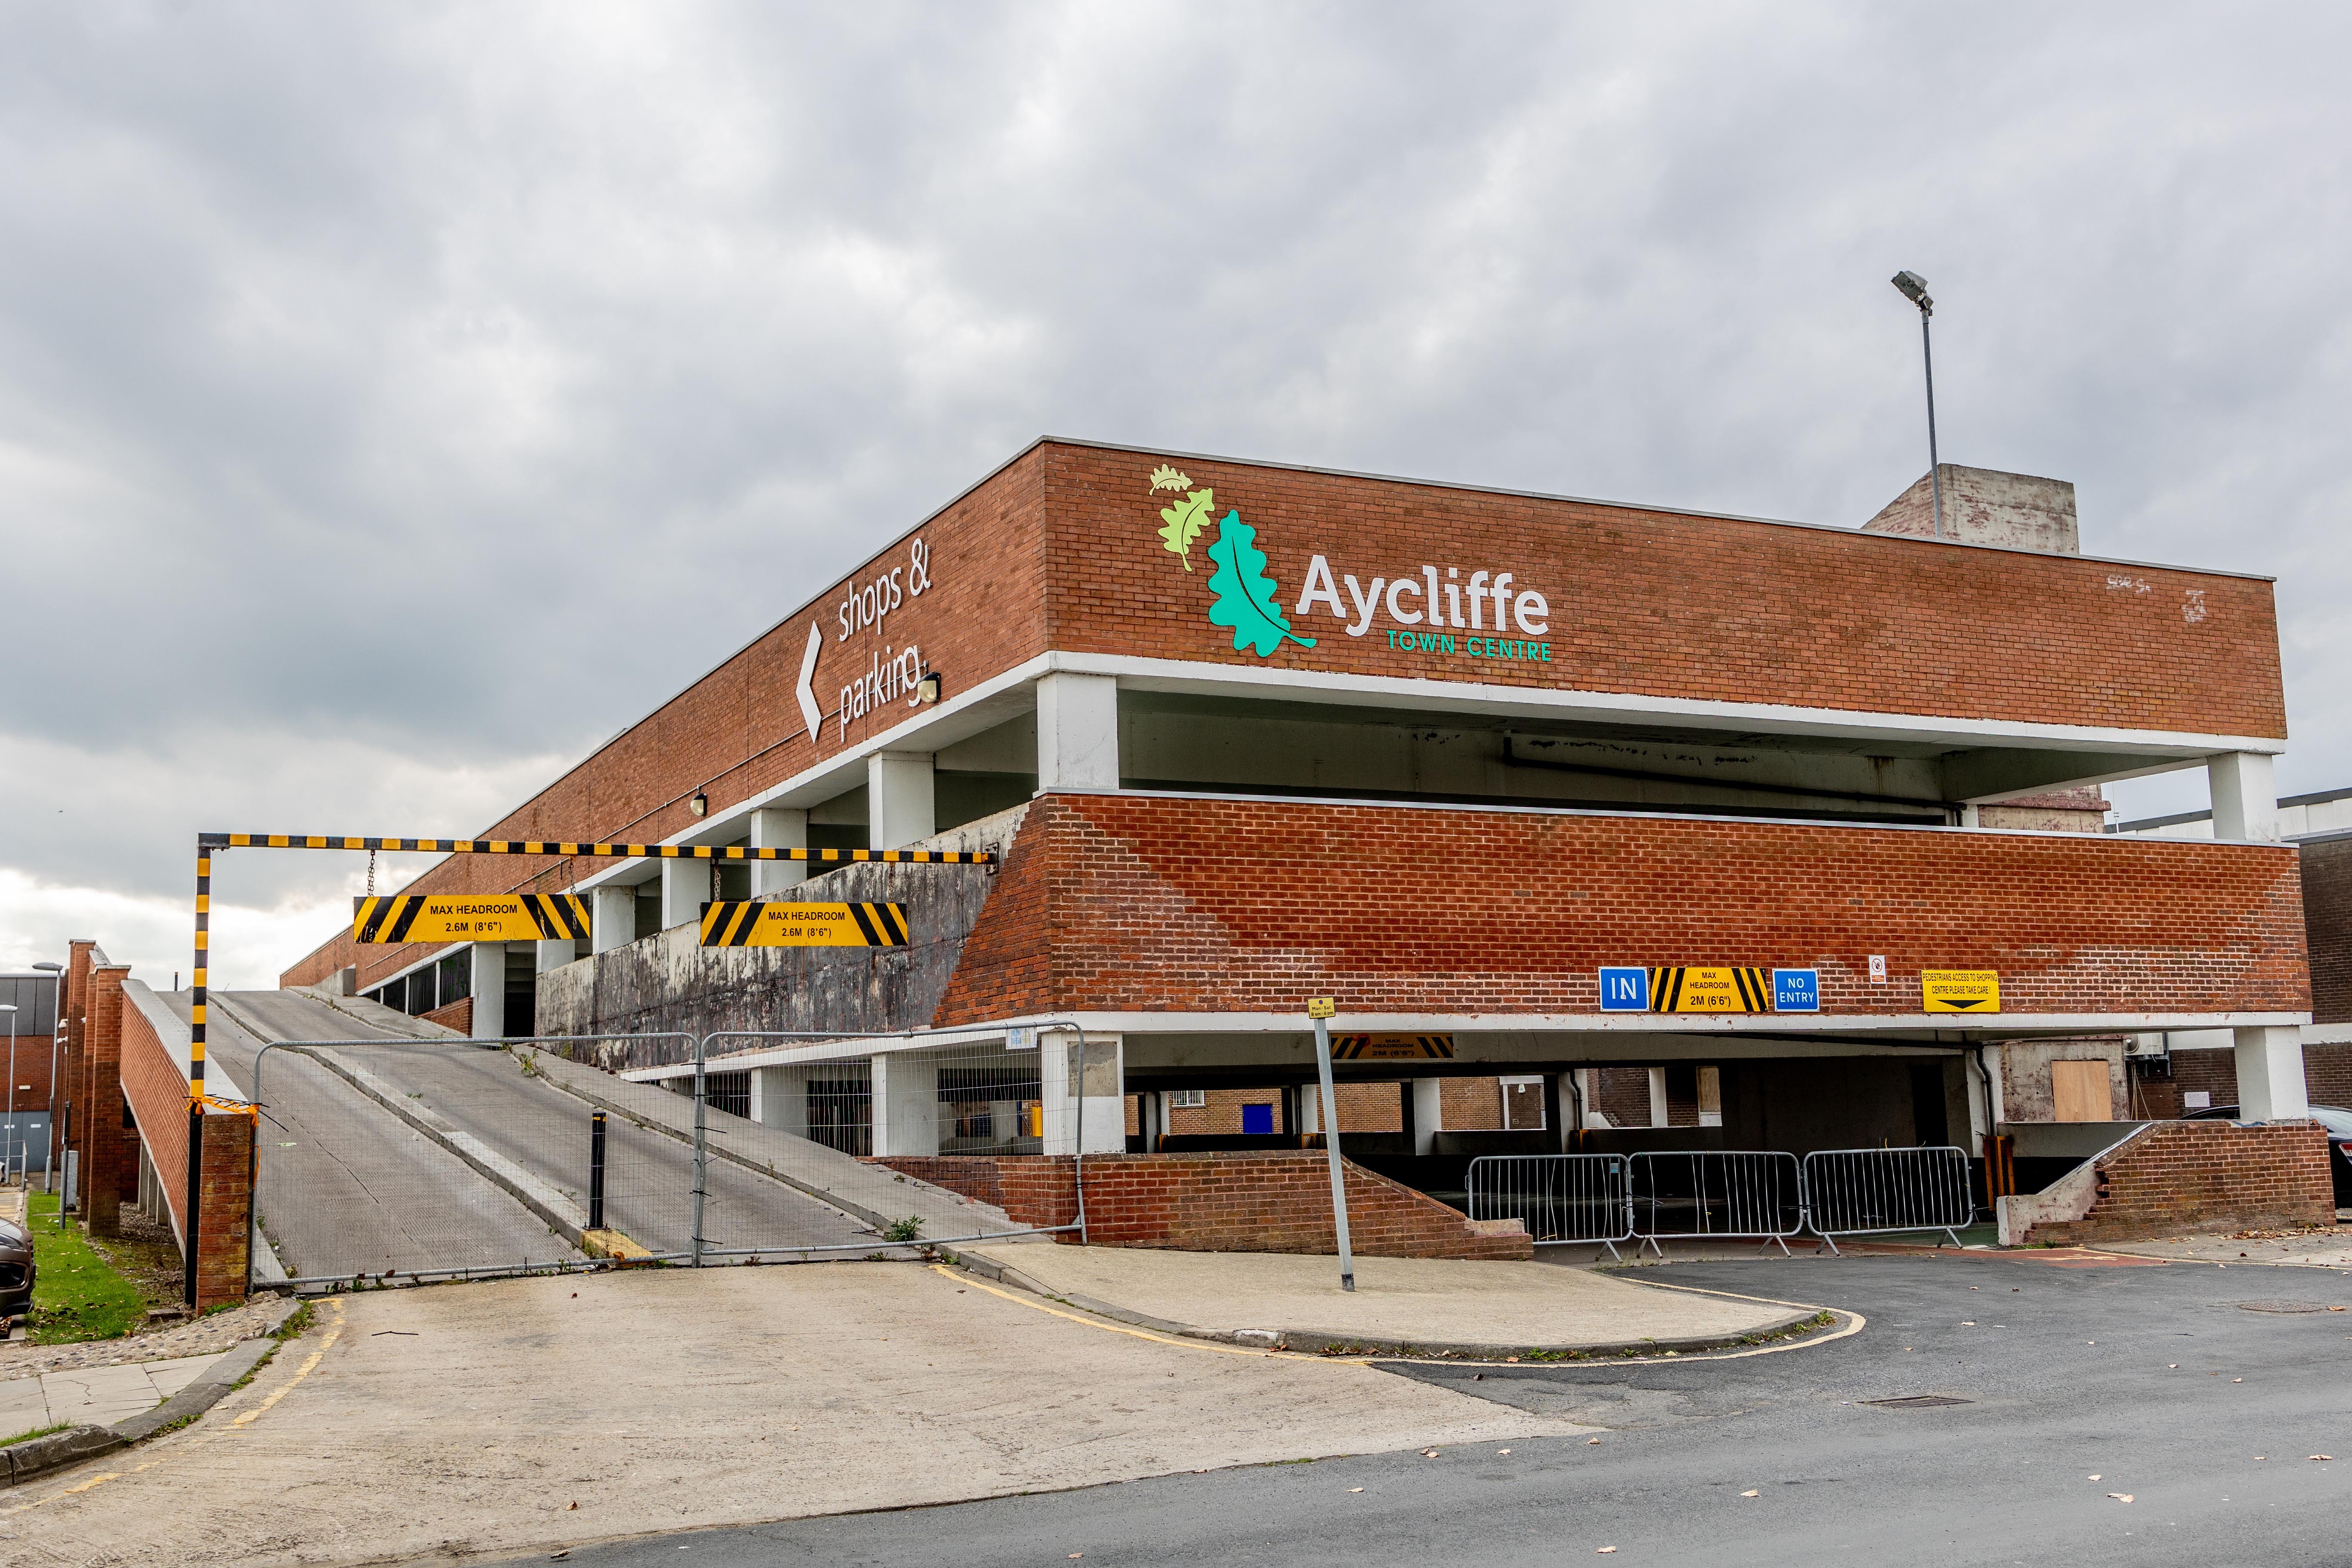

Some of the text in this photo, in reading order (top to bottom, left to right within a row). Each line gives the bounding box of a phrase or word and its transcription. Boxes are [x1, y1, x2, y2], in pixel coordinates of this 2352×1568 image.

[839, 538, 931, 642] shops &
[1295, 554, 1549, 637] Aycliffe
[1386, 630, 1551, 662] TOWN CENTRE
[840, 645, 922, 742] parking
[430, 904, 518, 915] MAX HEADROOM
[769, 912, 845, 920] MAX HEADROOM
[445, 922, 469, 932] 2.6M
[782, 928, 802, 937] 2.6M
[1923, 973, 1997, 982] PEDESTRIANS ACCESS TO SHOPPING
[1788, 978, 1804, 988] NO
[1611, 977, 1636, 1000] IN
[1932, 986, 1948, 994] CENTRE
[1949, 986, 1965, 994] PLEASE
[1966, 986, 1976, 994] TAKE
[1977, 986, 1988, 994] CARE
[1690, 995, 1704, 1005] 2M
[1779, 992, 1814, 1003] ENTRY
